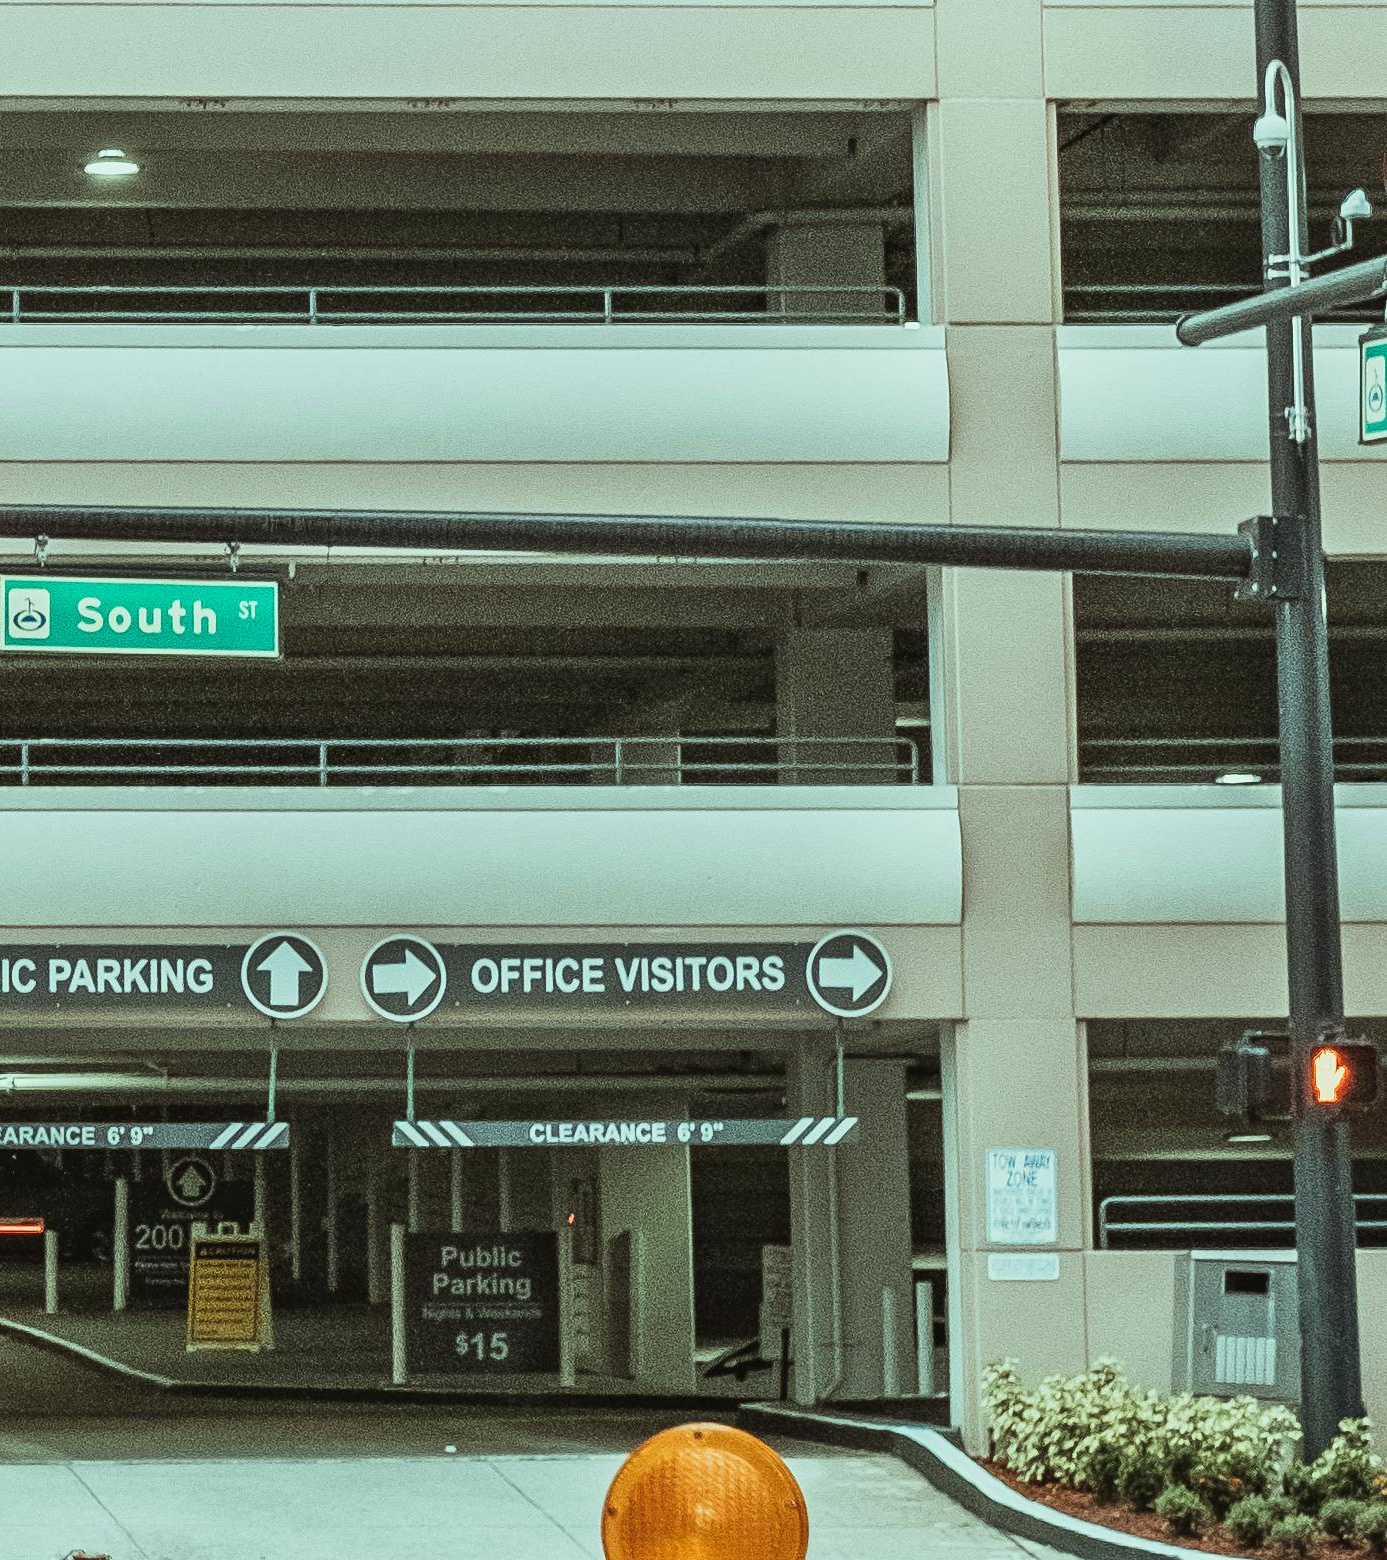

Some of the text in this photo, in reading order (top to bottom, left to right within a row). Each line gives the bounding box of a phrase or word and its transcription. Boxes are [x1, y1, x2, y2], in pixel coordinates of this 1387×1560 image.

[77, 596, 259, 635] South ST
[48, 958, 214, 994] PARKING
[471, 956, 786, 993] OFFICE VISITORS
[107, 1126, 125, 1145] 6'
[529, 1122, 666, 1143] CLEARANCE
[677, 1122, 695, 1142] 6'
[993, 1153, 1016, 1169] TOW
[1007, 1170, 1037, 1187] ZONE
[135, 1223, 184, 1250] 200
[440, 1244, 522, 1268] Public
[433, 1272, 531, 1300] Parking
[456, 1330, 509, 1361] $15
